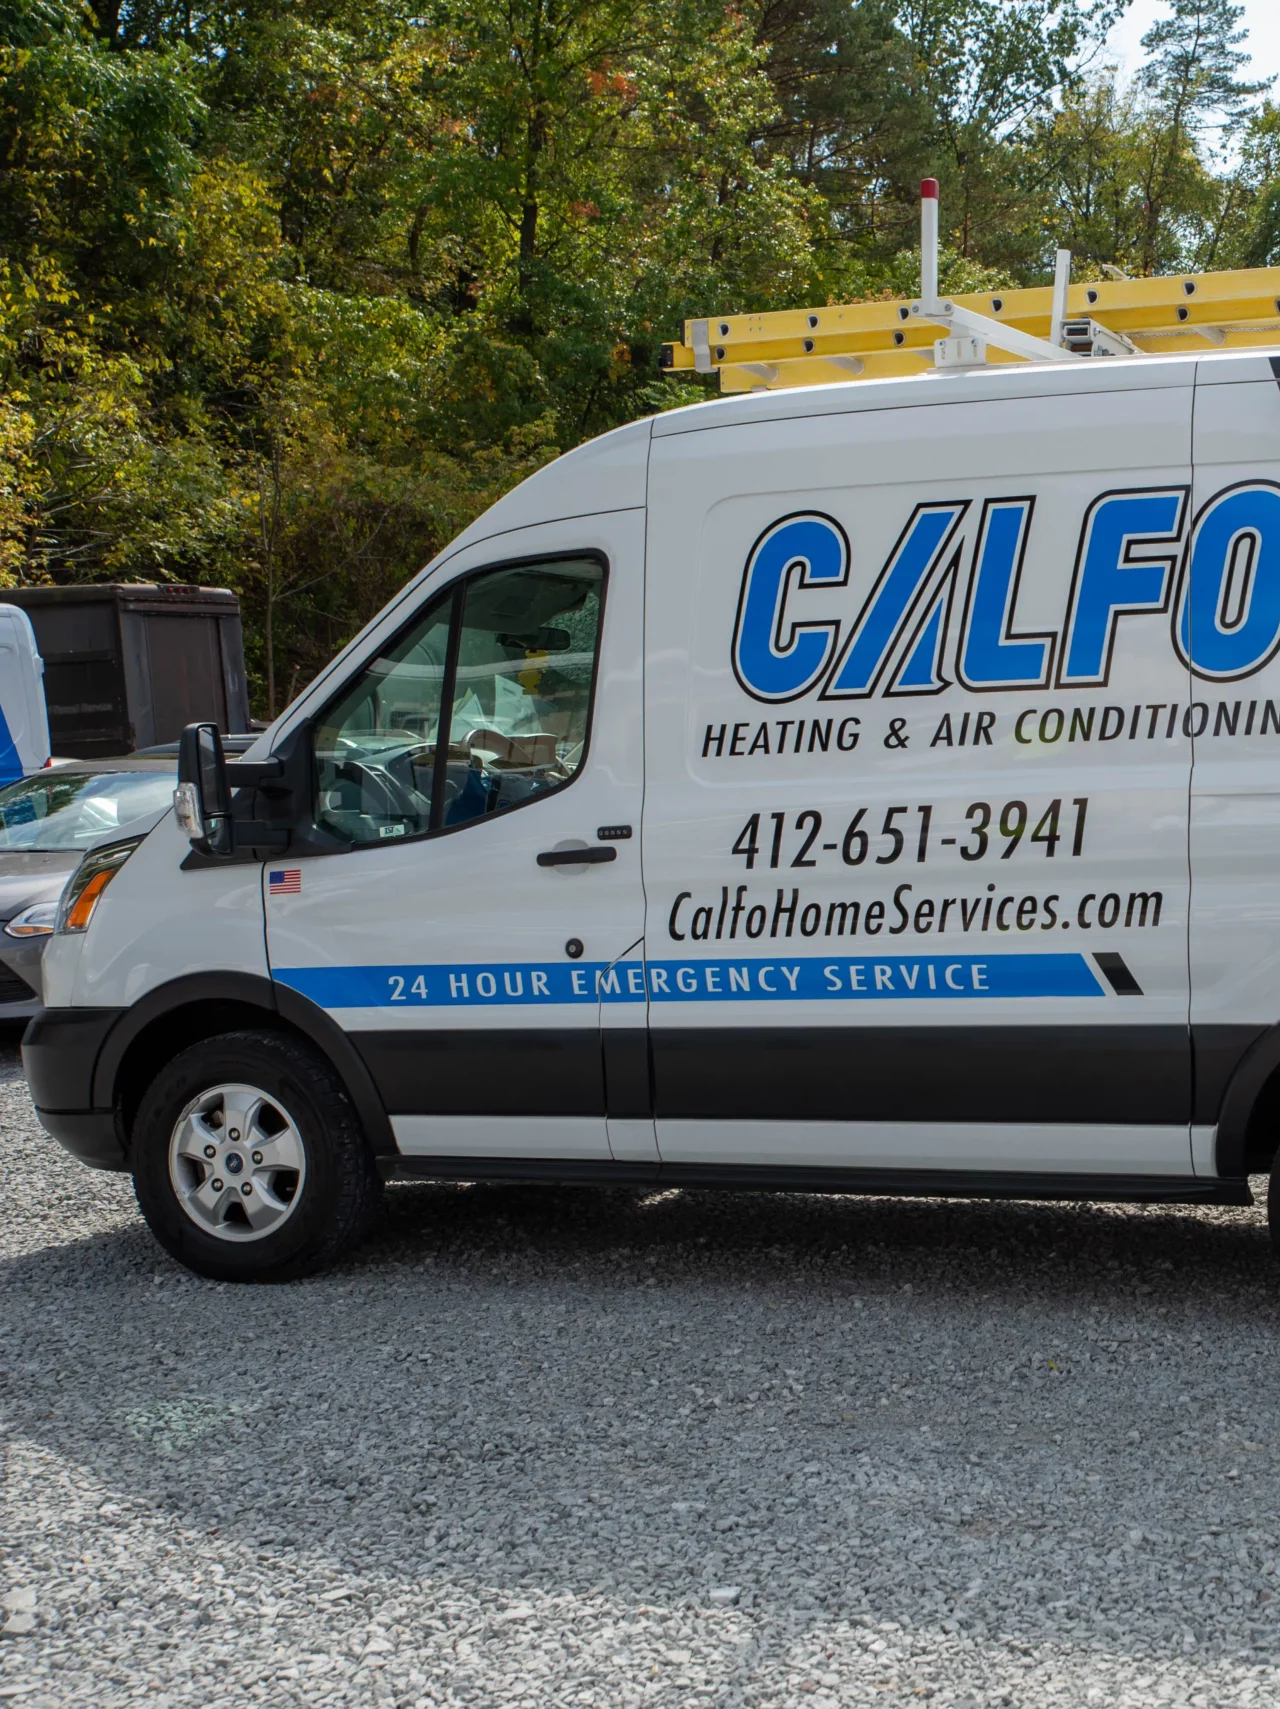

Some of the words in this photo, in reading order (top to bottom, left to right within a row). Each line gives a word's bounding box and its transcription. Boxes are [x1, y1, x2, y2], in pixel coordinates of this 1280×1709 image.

[701, 716, 861, 758] HEATING
[883, 717, 910, 749] &
[930, 711, 996, 748] AIR
[731, 798, 1089, 870] 412-651-3941
[668, 883, 1163, 941] CalfoHomeServices.com
[387, 974, 429, 1001] 24
[449, 970, 551, 998] HOUR
[571, 966, 802, 996] EMERGENCY
[826, 963, 990, 993] SERVICE
